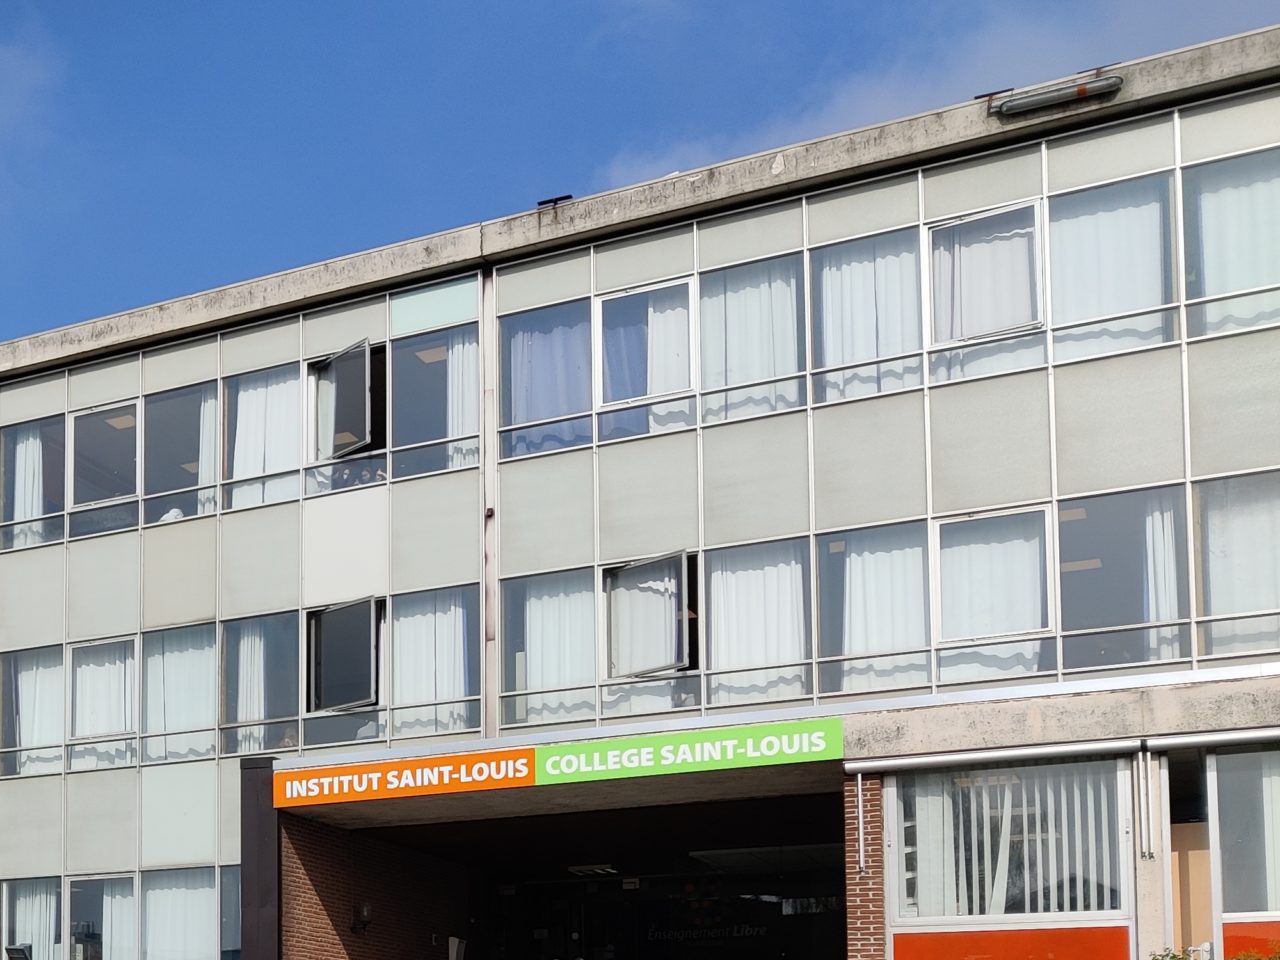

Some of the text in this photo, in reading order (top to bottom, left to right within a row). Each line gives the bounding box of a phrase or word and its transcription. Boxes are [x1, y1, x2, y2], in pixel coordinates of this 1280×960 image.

[545, 731, 827, 775] COLLEGE SAINT-LOUIS
[285, 758, 529, 798] INSTITUT SAINT-LOUIS
[732, 924, 769, 937] Libre
